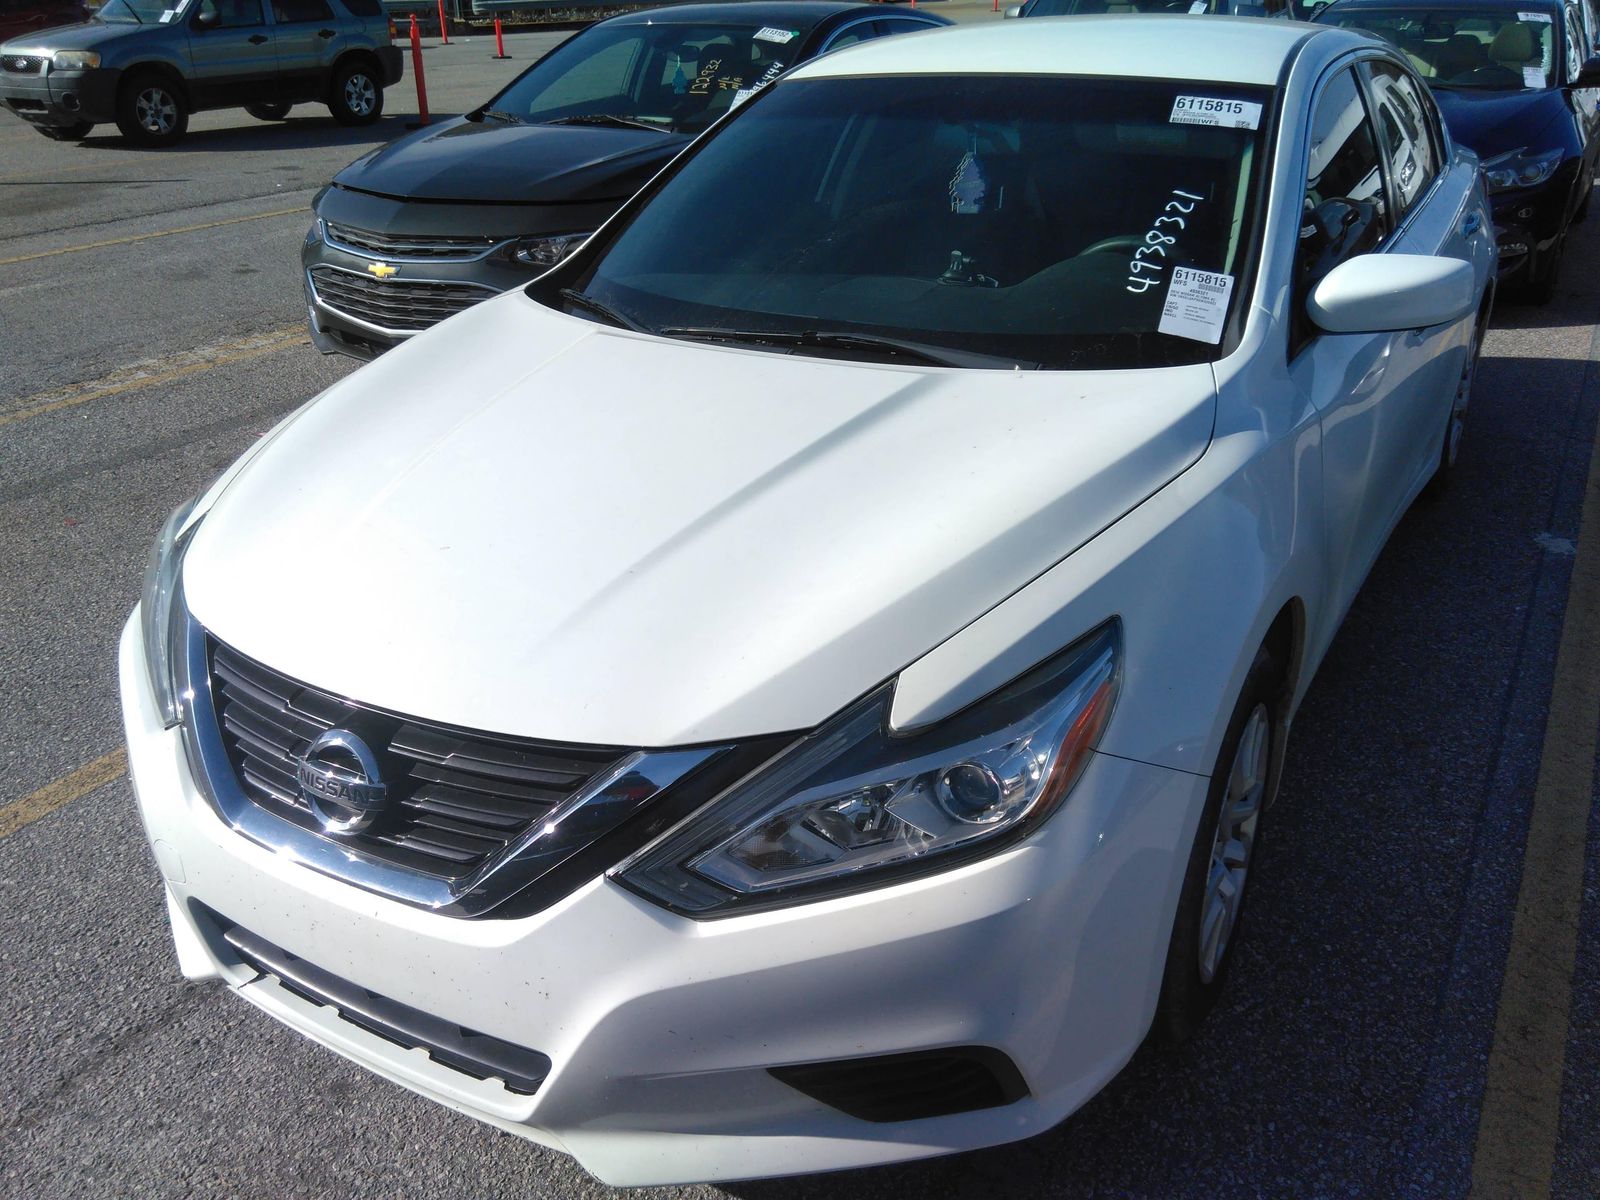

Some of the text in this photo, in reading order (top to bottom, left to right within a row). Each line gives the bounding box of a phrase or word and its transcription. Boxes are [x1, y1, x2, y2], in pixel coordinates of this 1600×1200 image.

[1176, 97, 1243, 114] 6115815
[1127, 190, 1204, 293] 4938321
[1175, 269, 1227, 287] 6115815
[300, 768, 370, 805] NISSAN
